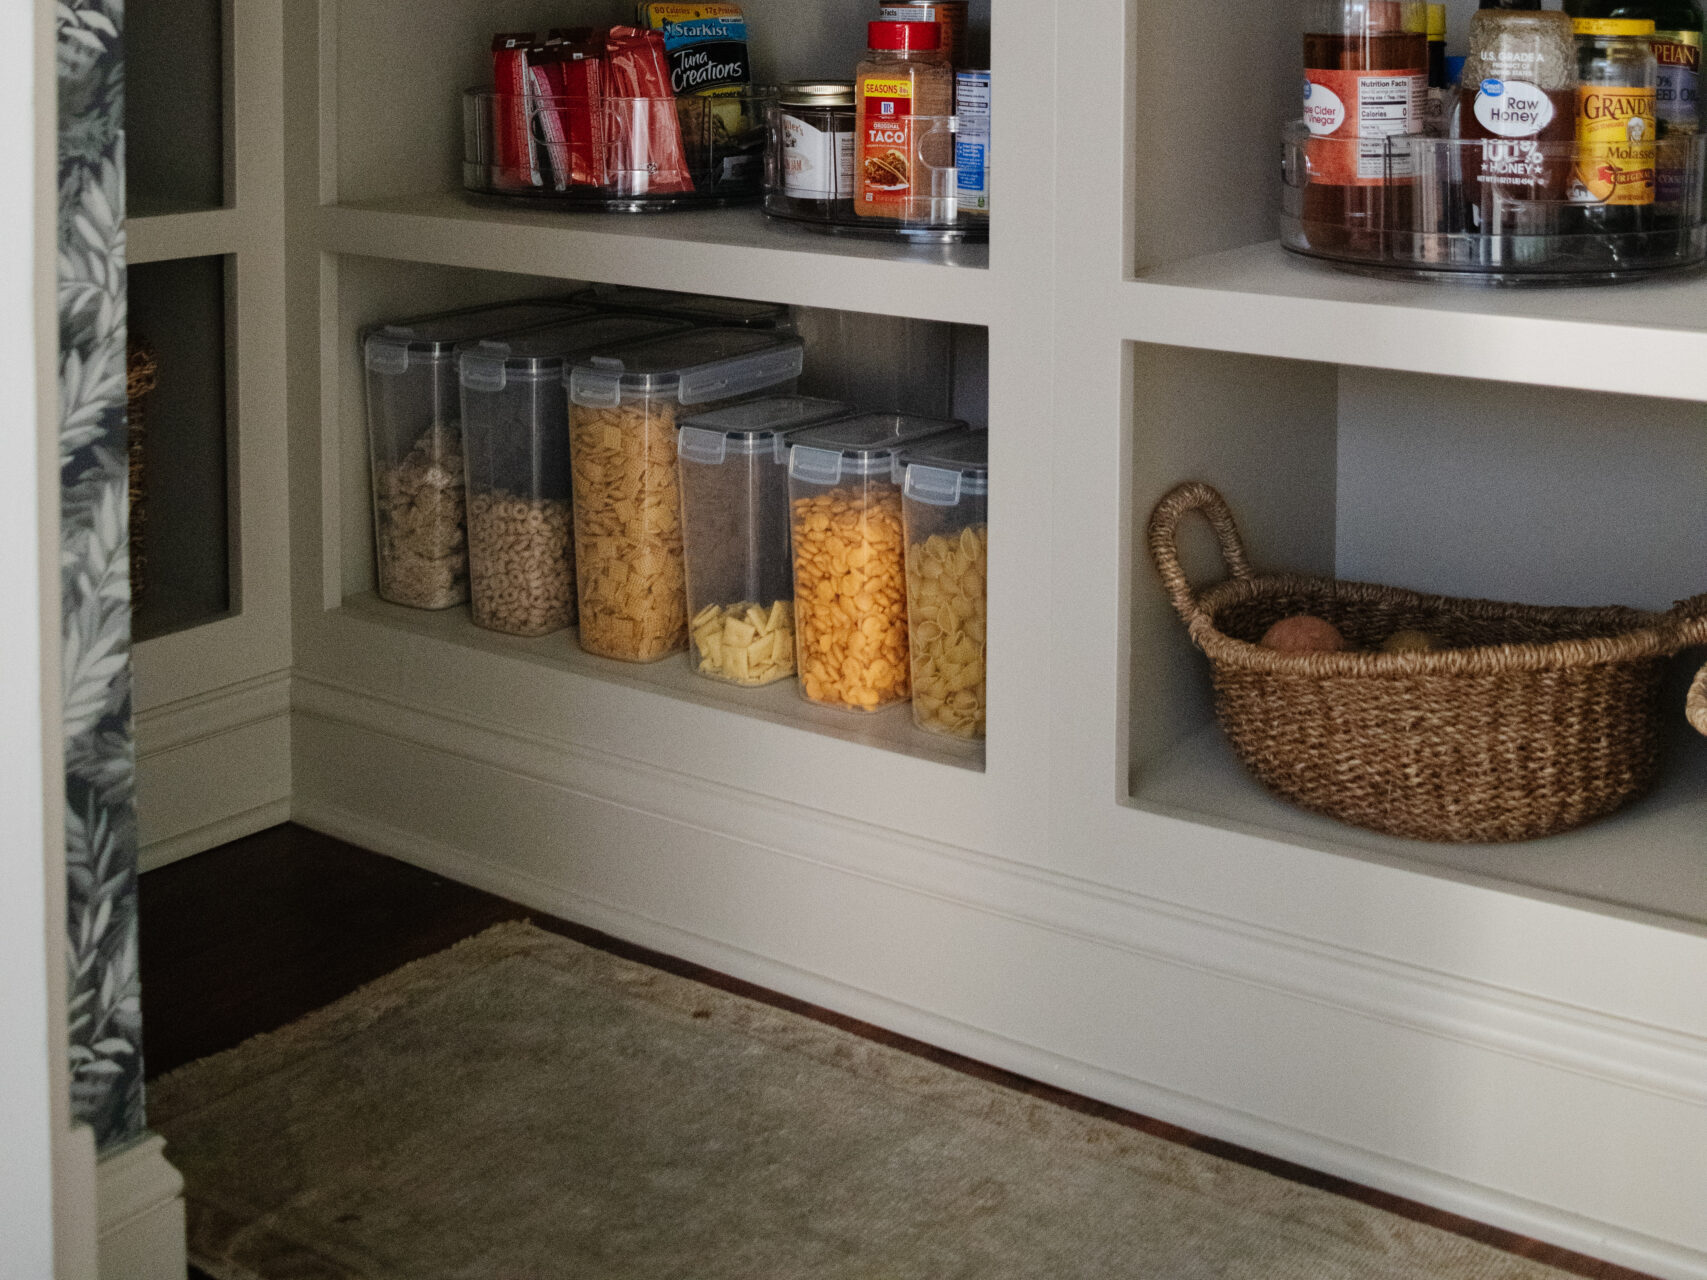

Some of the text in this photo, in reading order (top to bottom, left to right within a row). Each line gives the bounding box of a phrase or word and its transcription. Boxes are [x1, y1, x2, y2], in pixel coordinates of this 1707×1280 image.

[675, 23, 728, 36] StarKist
[674, 49, 708, 71] Tuna
[1653, 44, 1695, 64] PEIAN
[672, 61, 742, 92] Creations
[866, 83, 898, 94] SEASONS
[1314, 105, 1336, 115] Cider
[1507, 97, 1539, 110] Raw
[1402, 107, 1407, 117] 0
[1491, 108, 1539, 125] Honey
[1309, 116, 1335, 127] inegar
[868, 130, 905, 143] TACO
[1480, 138, 1544, 163] 100%
[1489, 162, 1532, 175] HONEY
